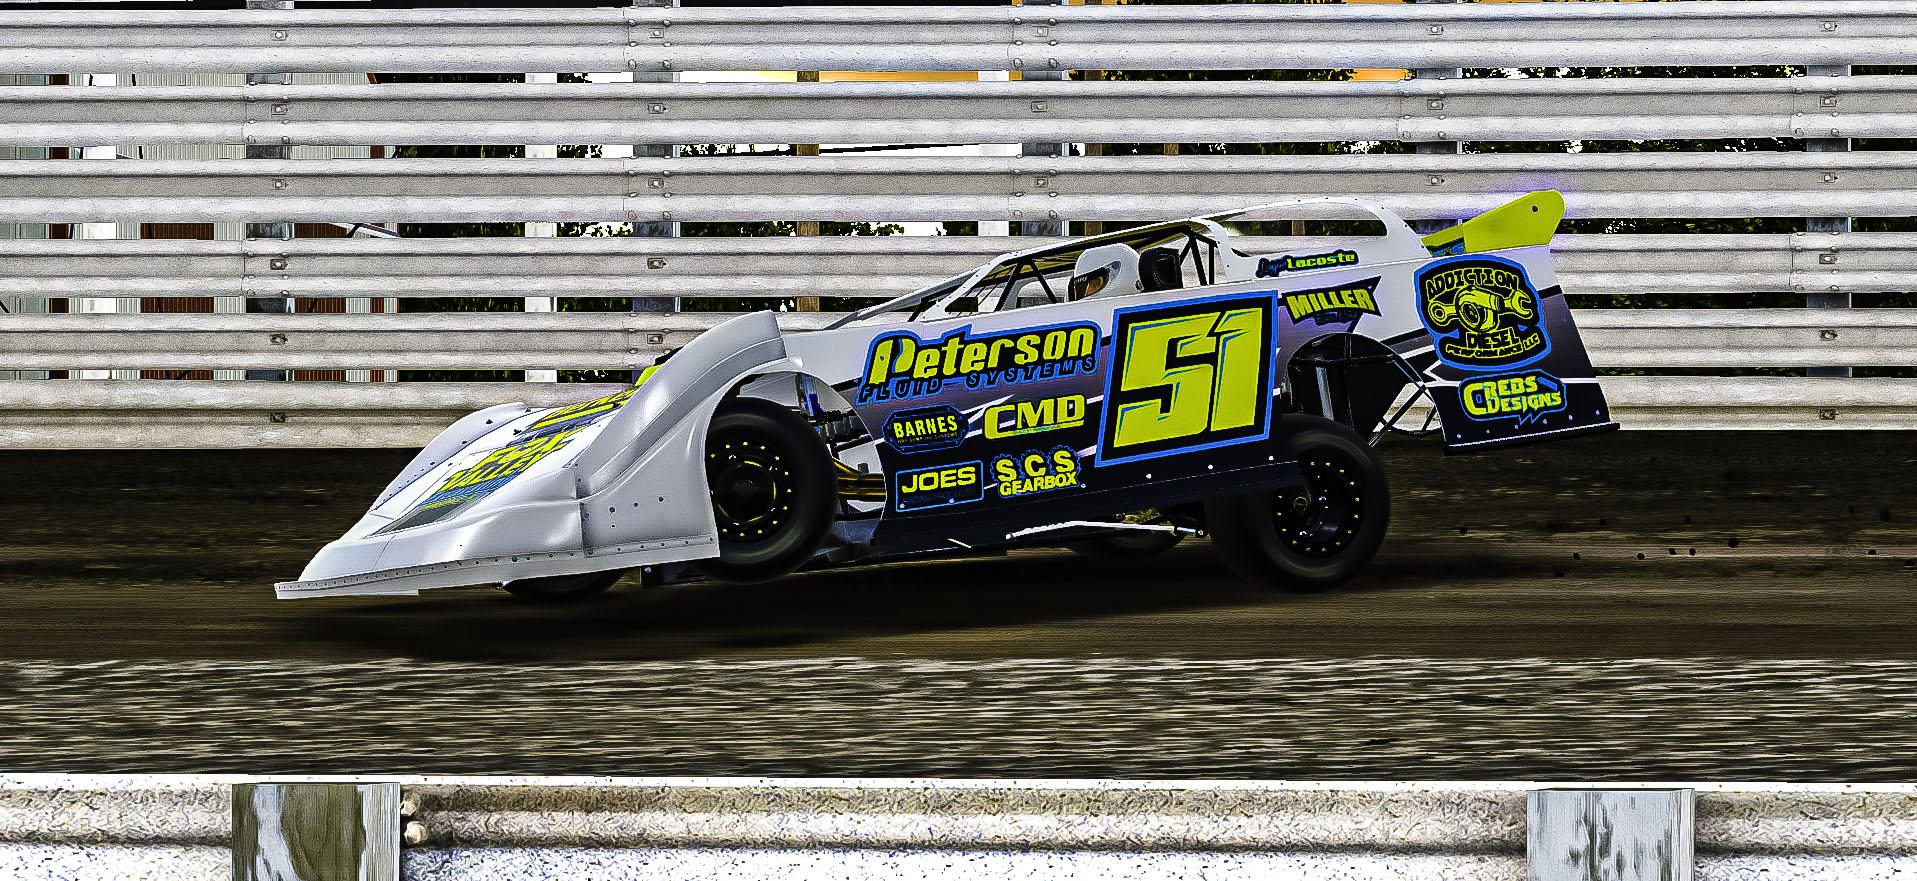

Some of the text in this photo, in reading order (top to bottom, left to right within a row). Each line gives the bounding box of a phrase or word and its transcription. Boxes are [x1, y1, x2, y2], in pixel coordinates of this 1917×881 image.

[1426, 267, 1519, 301] ADDICTION
[1286, 288, 1376, 320] MILLER
[1466, 327, 1520, 350] DIESEL
[869, 328, 1094, 385] Peterson
[862, 356, 1093, 400] FLUID SYSTEMS
[1113, 308, 1263, 447] 51
[984, 394, 1085, 439] CMD
[1486, 391, 1562, 414] DESIGNS
[893, 415, 958, 438] BARNES
[901, 466, 977, 494] JOES
[1000, 471, 1077, 496] GEARBOX
